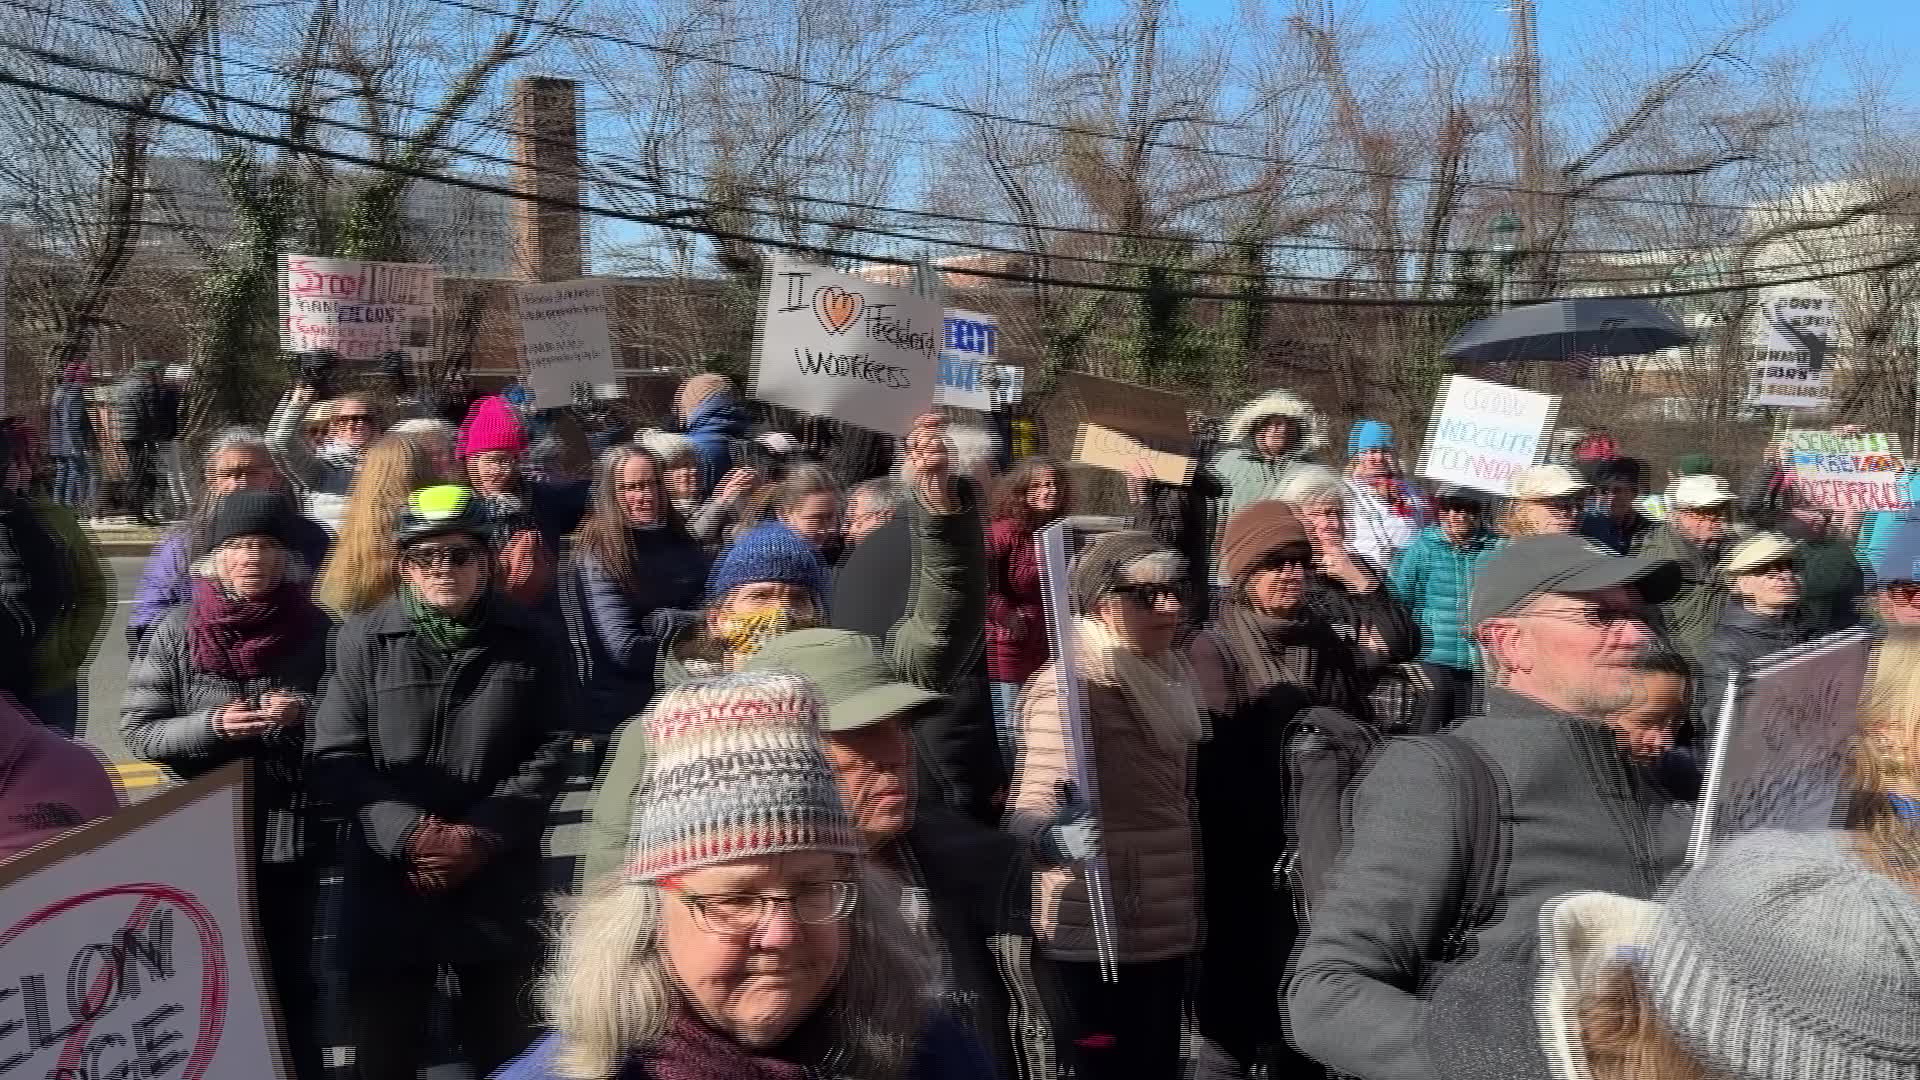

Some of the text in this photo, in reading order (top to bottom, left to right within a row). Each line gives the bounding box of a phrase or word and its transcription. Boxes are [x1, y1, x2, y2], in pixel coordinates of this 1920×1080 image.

[285, 260, 436, 306] STOP DOGE
[777, 272, 811, 313] I
[299, 298, 342, 313] AND
[1777, 297, 1835, 311] DON'T
[863, 302, 945, 361] Federal
[1792, 315, 1835, 328] BUY
[794, 347, 911, 390] Workers
[1756, 350, 1809, 363] WHAT
[1757, 366, 1821, 381] ELON'S
[1757, 383, 1830, 398] SELLING
[1431, 418, 1544, 456] NO CUTS
[1783, 431, 1862, 455] SCIENCE
[1428, 445, 1469, 470] TO
[1790, 477, 1845, 508] DOGE
